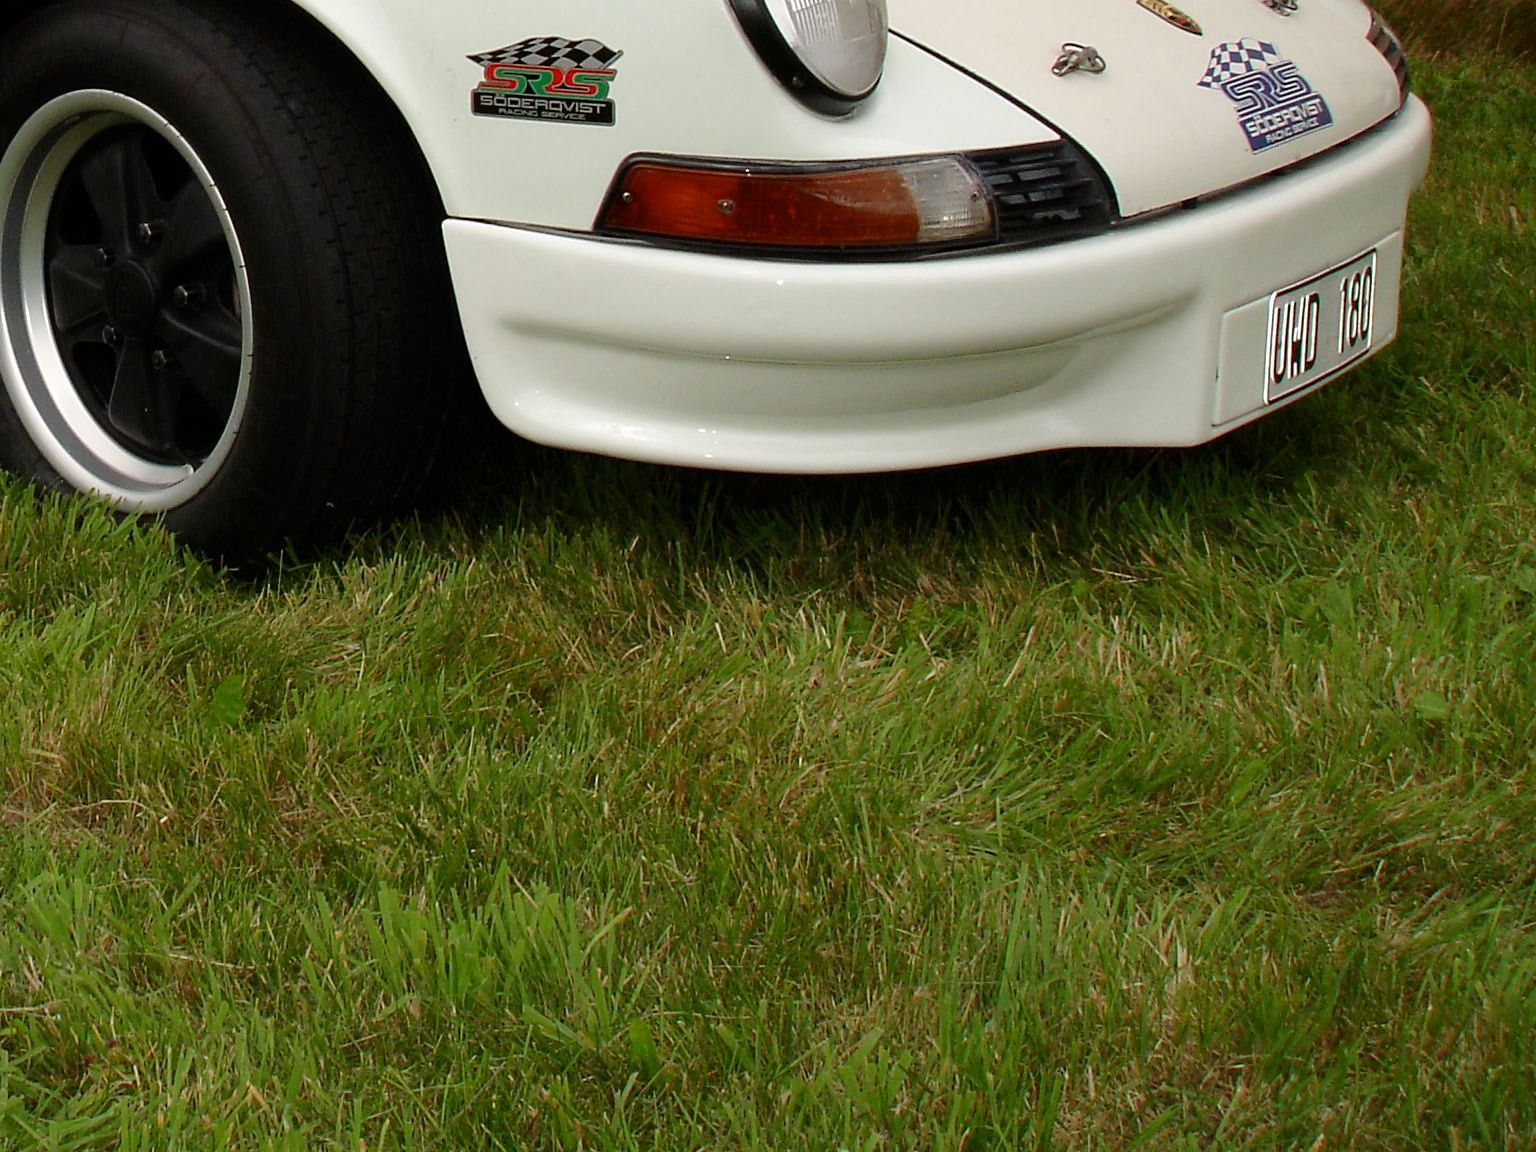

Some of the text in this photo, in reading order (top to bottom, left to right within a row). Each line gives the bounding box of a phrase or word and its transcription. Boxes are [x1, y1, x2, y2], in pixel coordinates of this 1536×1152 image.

[478, 63, 618, 101] SRS
[1219, 60, 1313, 118] SRS
[480, 94, 606, 115] SÖDERQVIST
[498, 108, 586, 121] RACING SERVICE
[1338, 266, 1372, 355] 180
